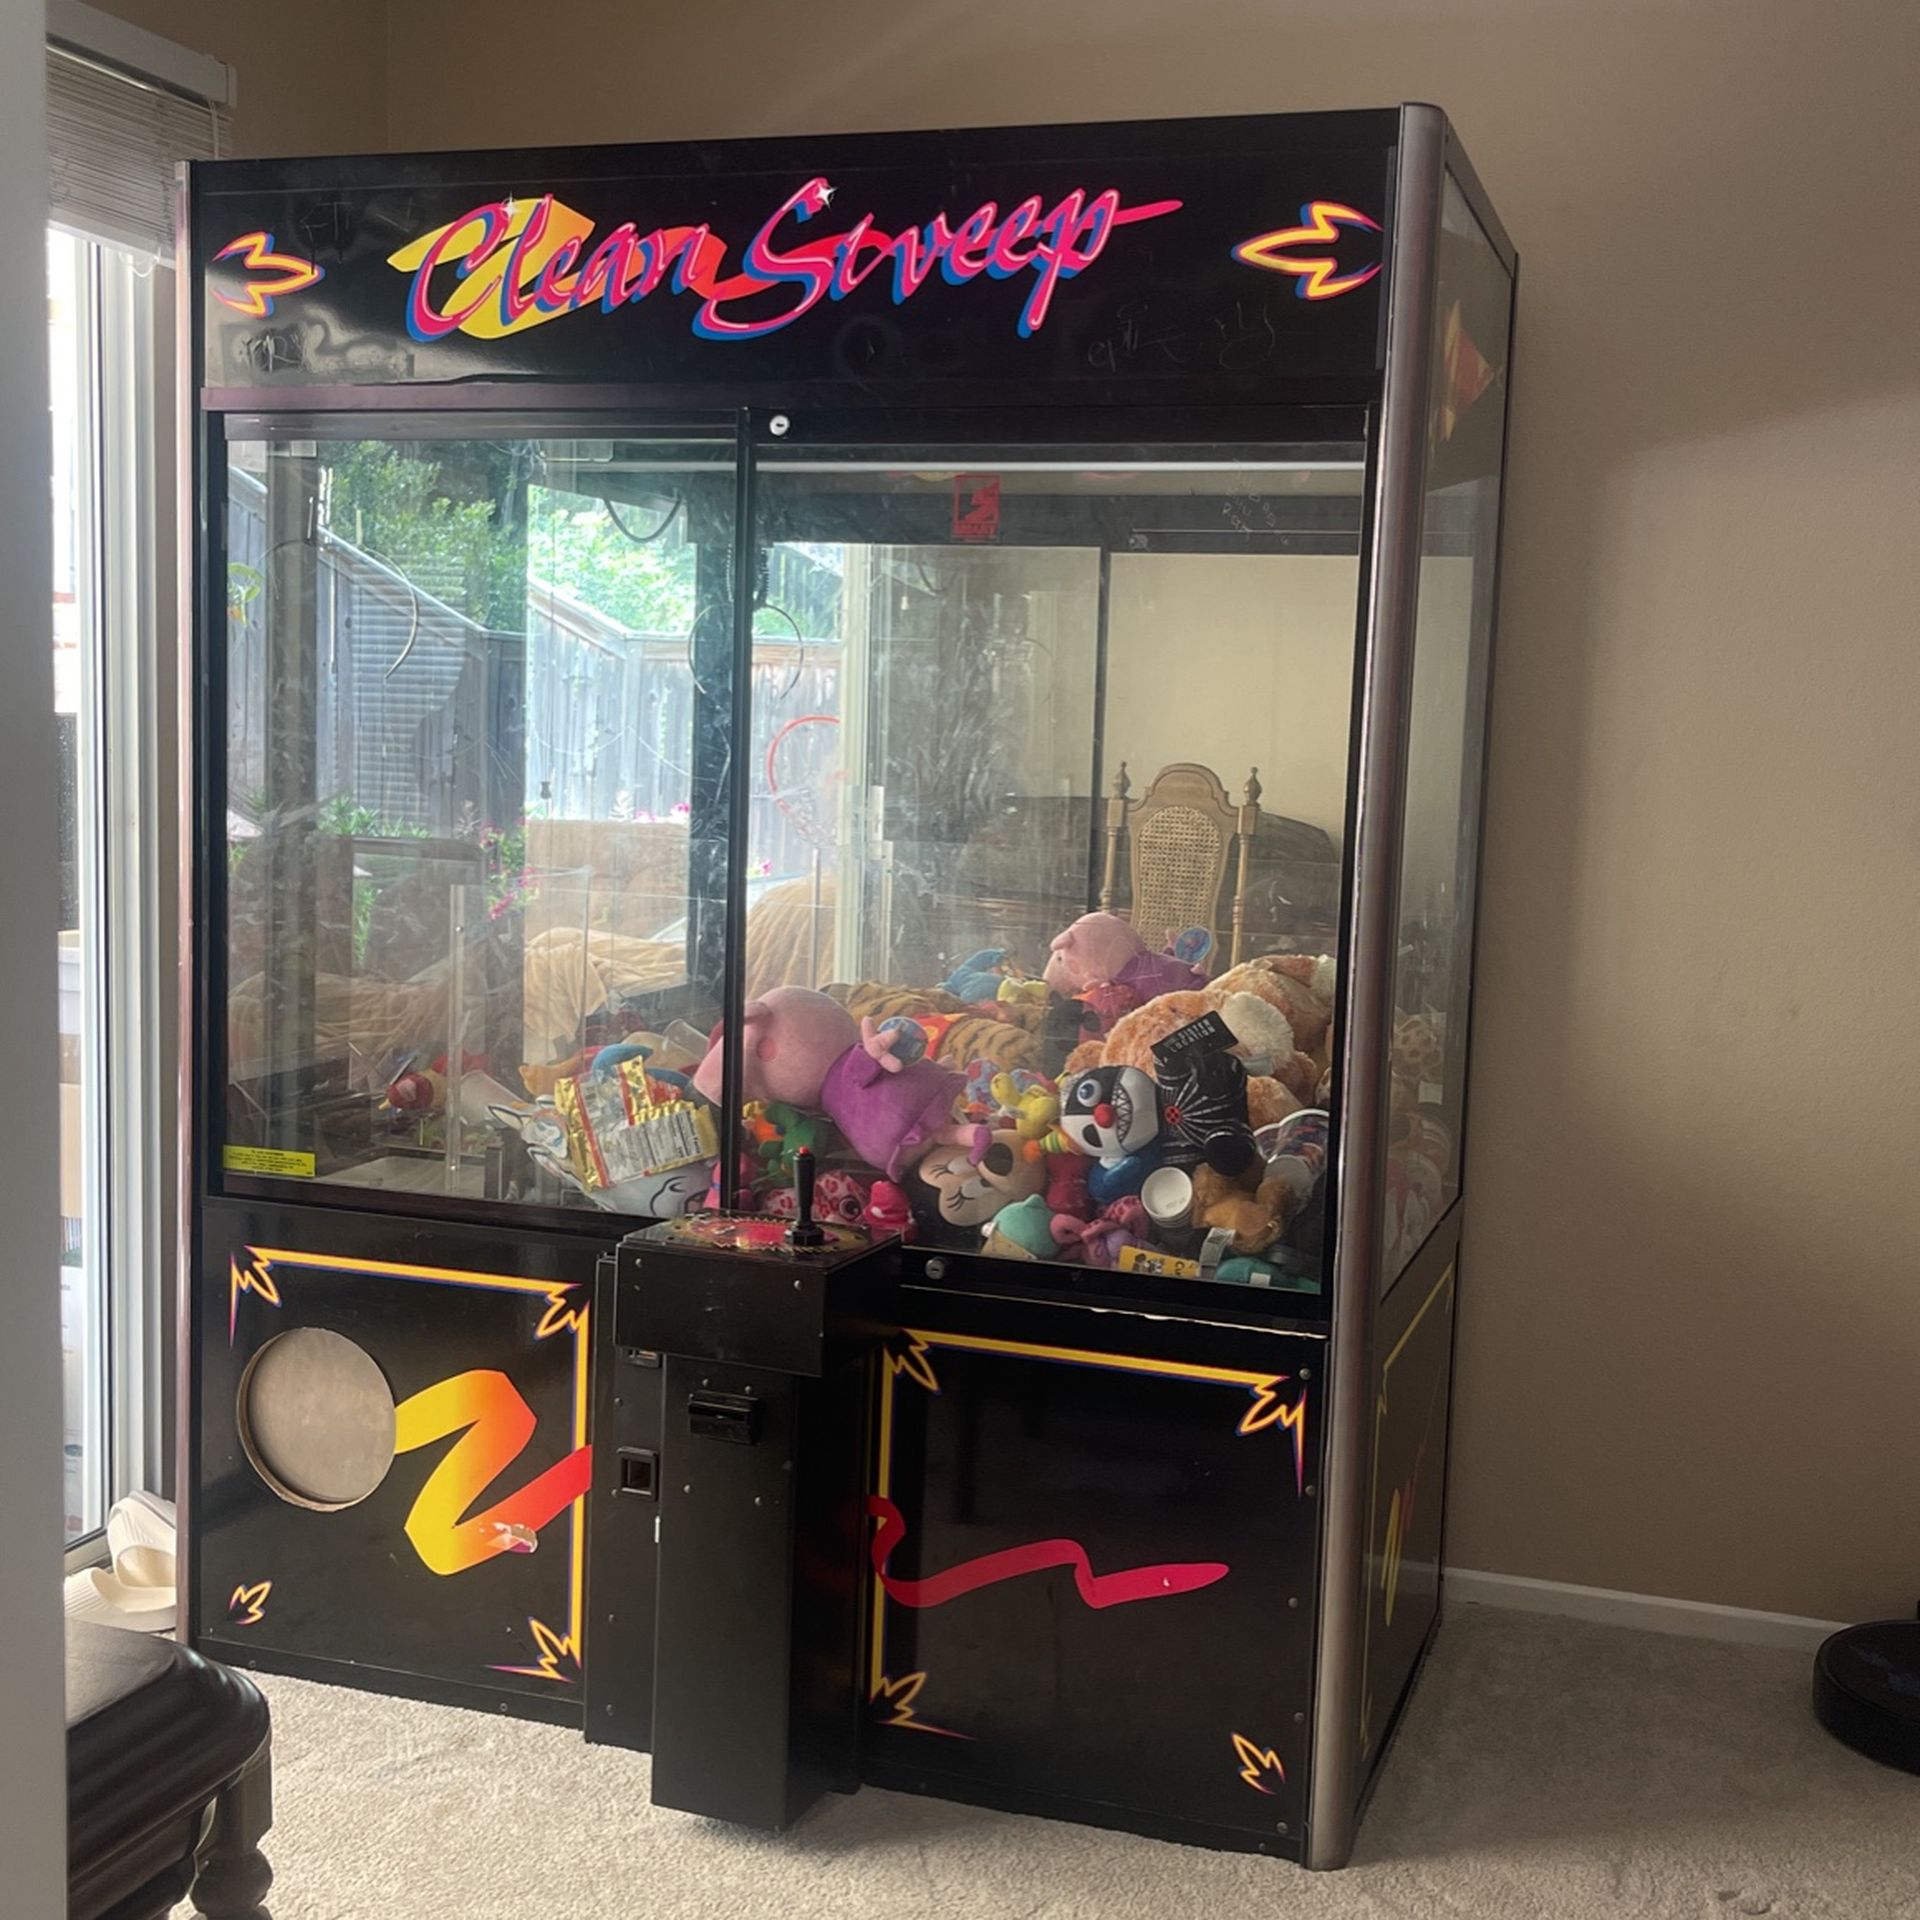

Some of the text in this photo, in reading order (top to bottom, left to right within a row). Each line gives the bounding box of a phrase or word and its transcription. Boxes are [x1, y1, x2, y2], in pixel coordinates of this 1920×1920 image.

[406, 193, 711, 343] Clean
[692, 176, 1122, 340] Sweep
[1168, 1025, 1216, 1054] LOCATION
[1177, 1019, 1211, 1041] SISTER
